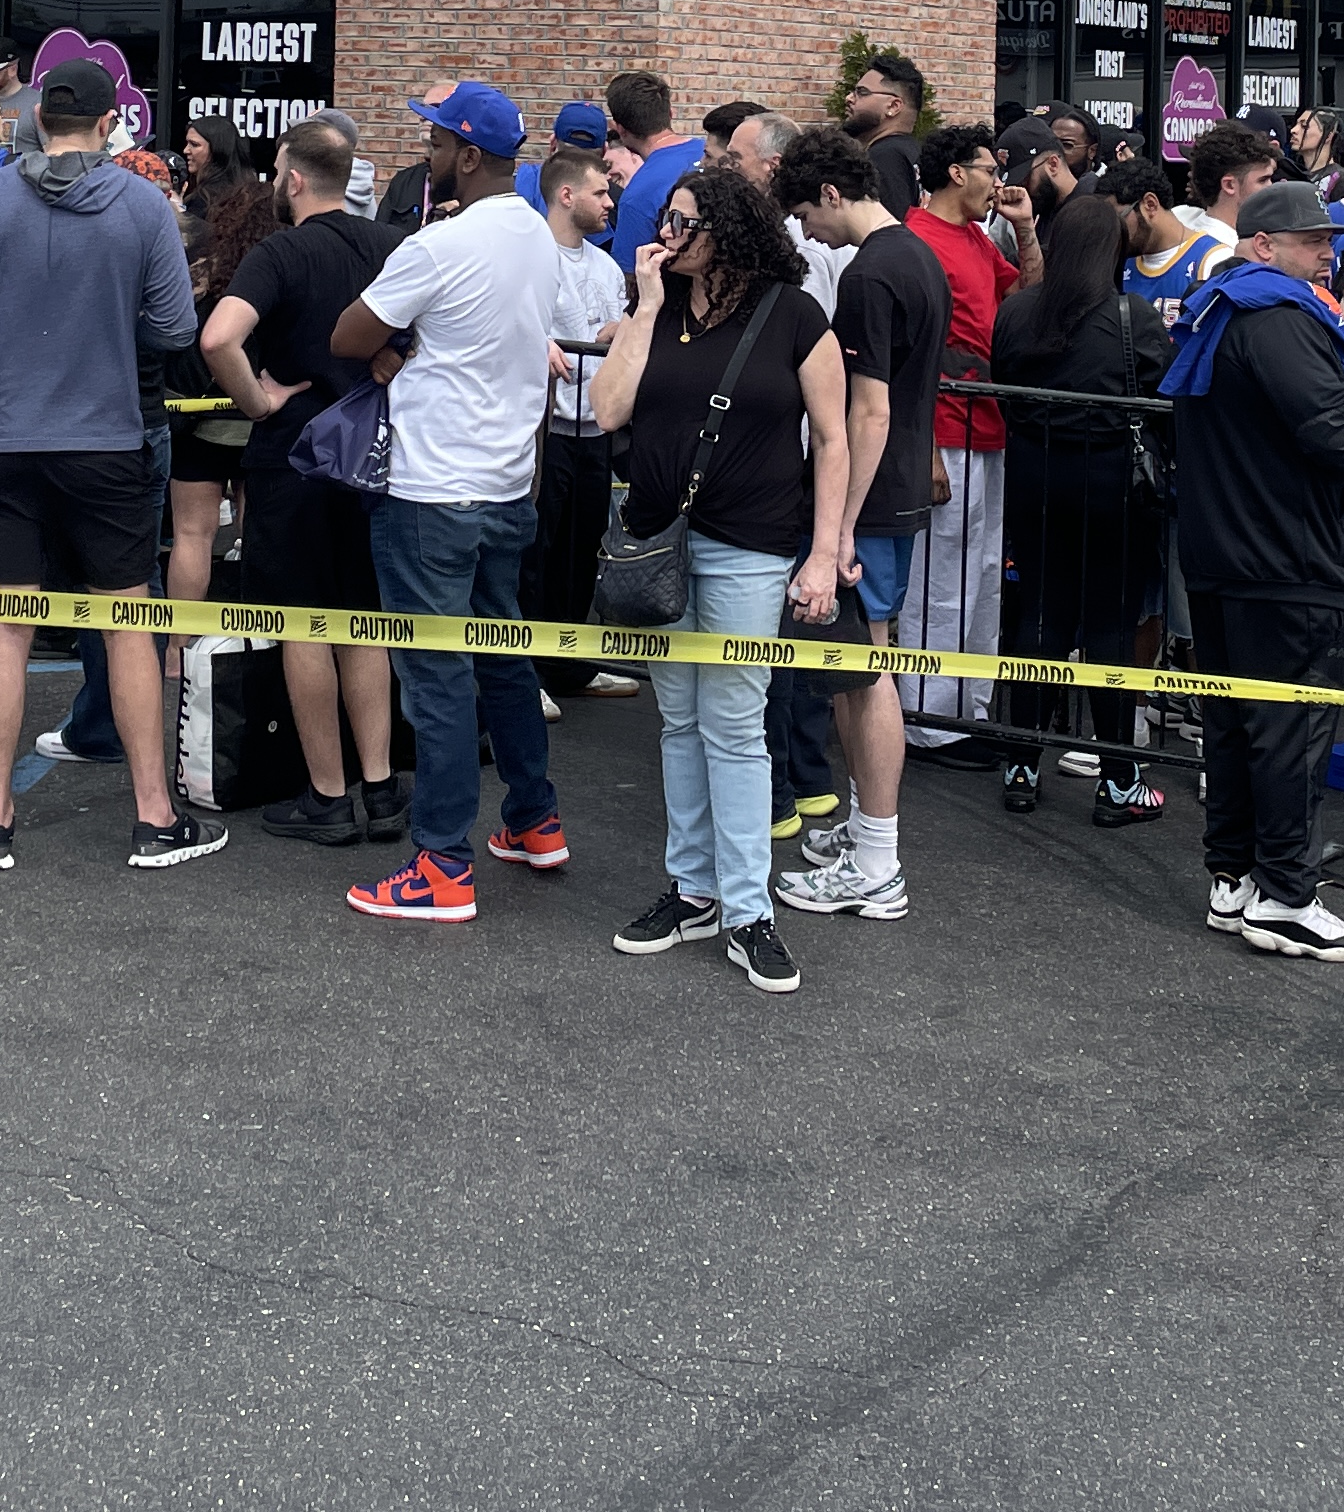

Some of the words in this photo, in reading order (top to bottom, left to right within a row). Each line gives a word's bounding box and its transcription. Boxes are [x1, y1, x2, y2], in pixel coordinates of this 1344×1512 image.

[201, 22, 317, 63] LARGEST
[1248, 15, 1297, 50] LARGEST
[1094, 50, 1125, 78] FIRST
[1243, 75, 1300, 107] SELECTION
[111, 601, 173, 627] CAUTION
[221, 607, 284, 634] CUIDADO
[350, 615, 414, 643] CAUTION
[464, 622, 532, 649] CUIDADO
[601, 631, 670, 657] CAUTION
[722, 639, 795, 664] CUIDADO
[867, 650, 941, 674] CAUTION
[998, 661, 1074, 684] CUIDADO
